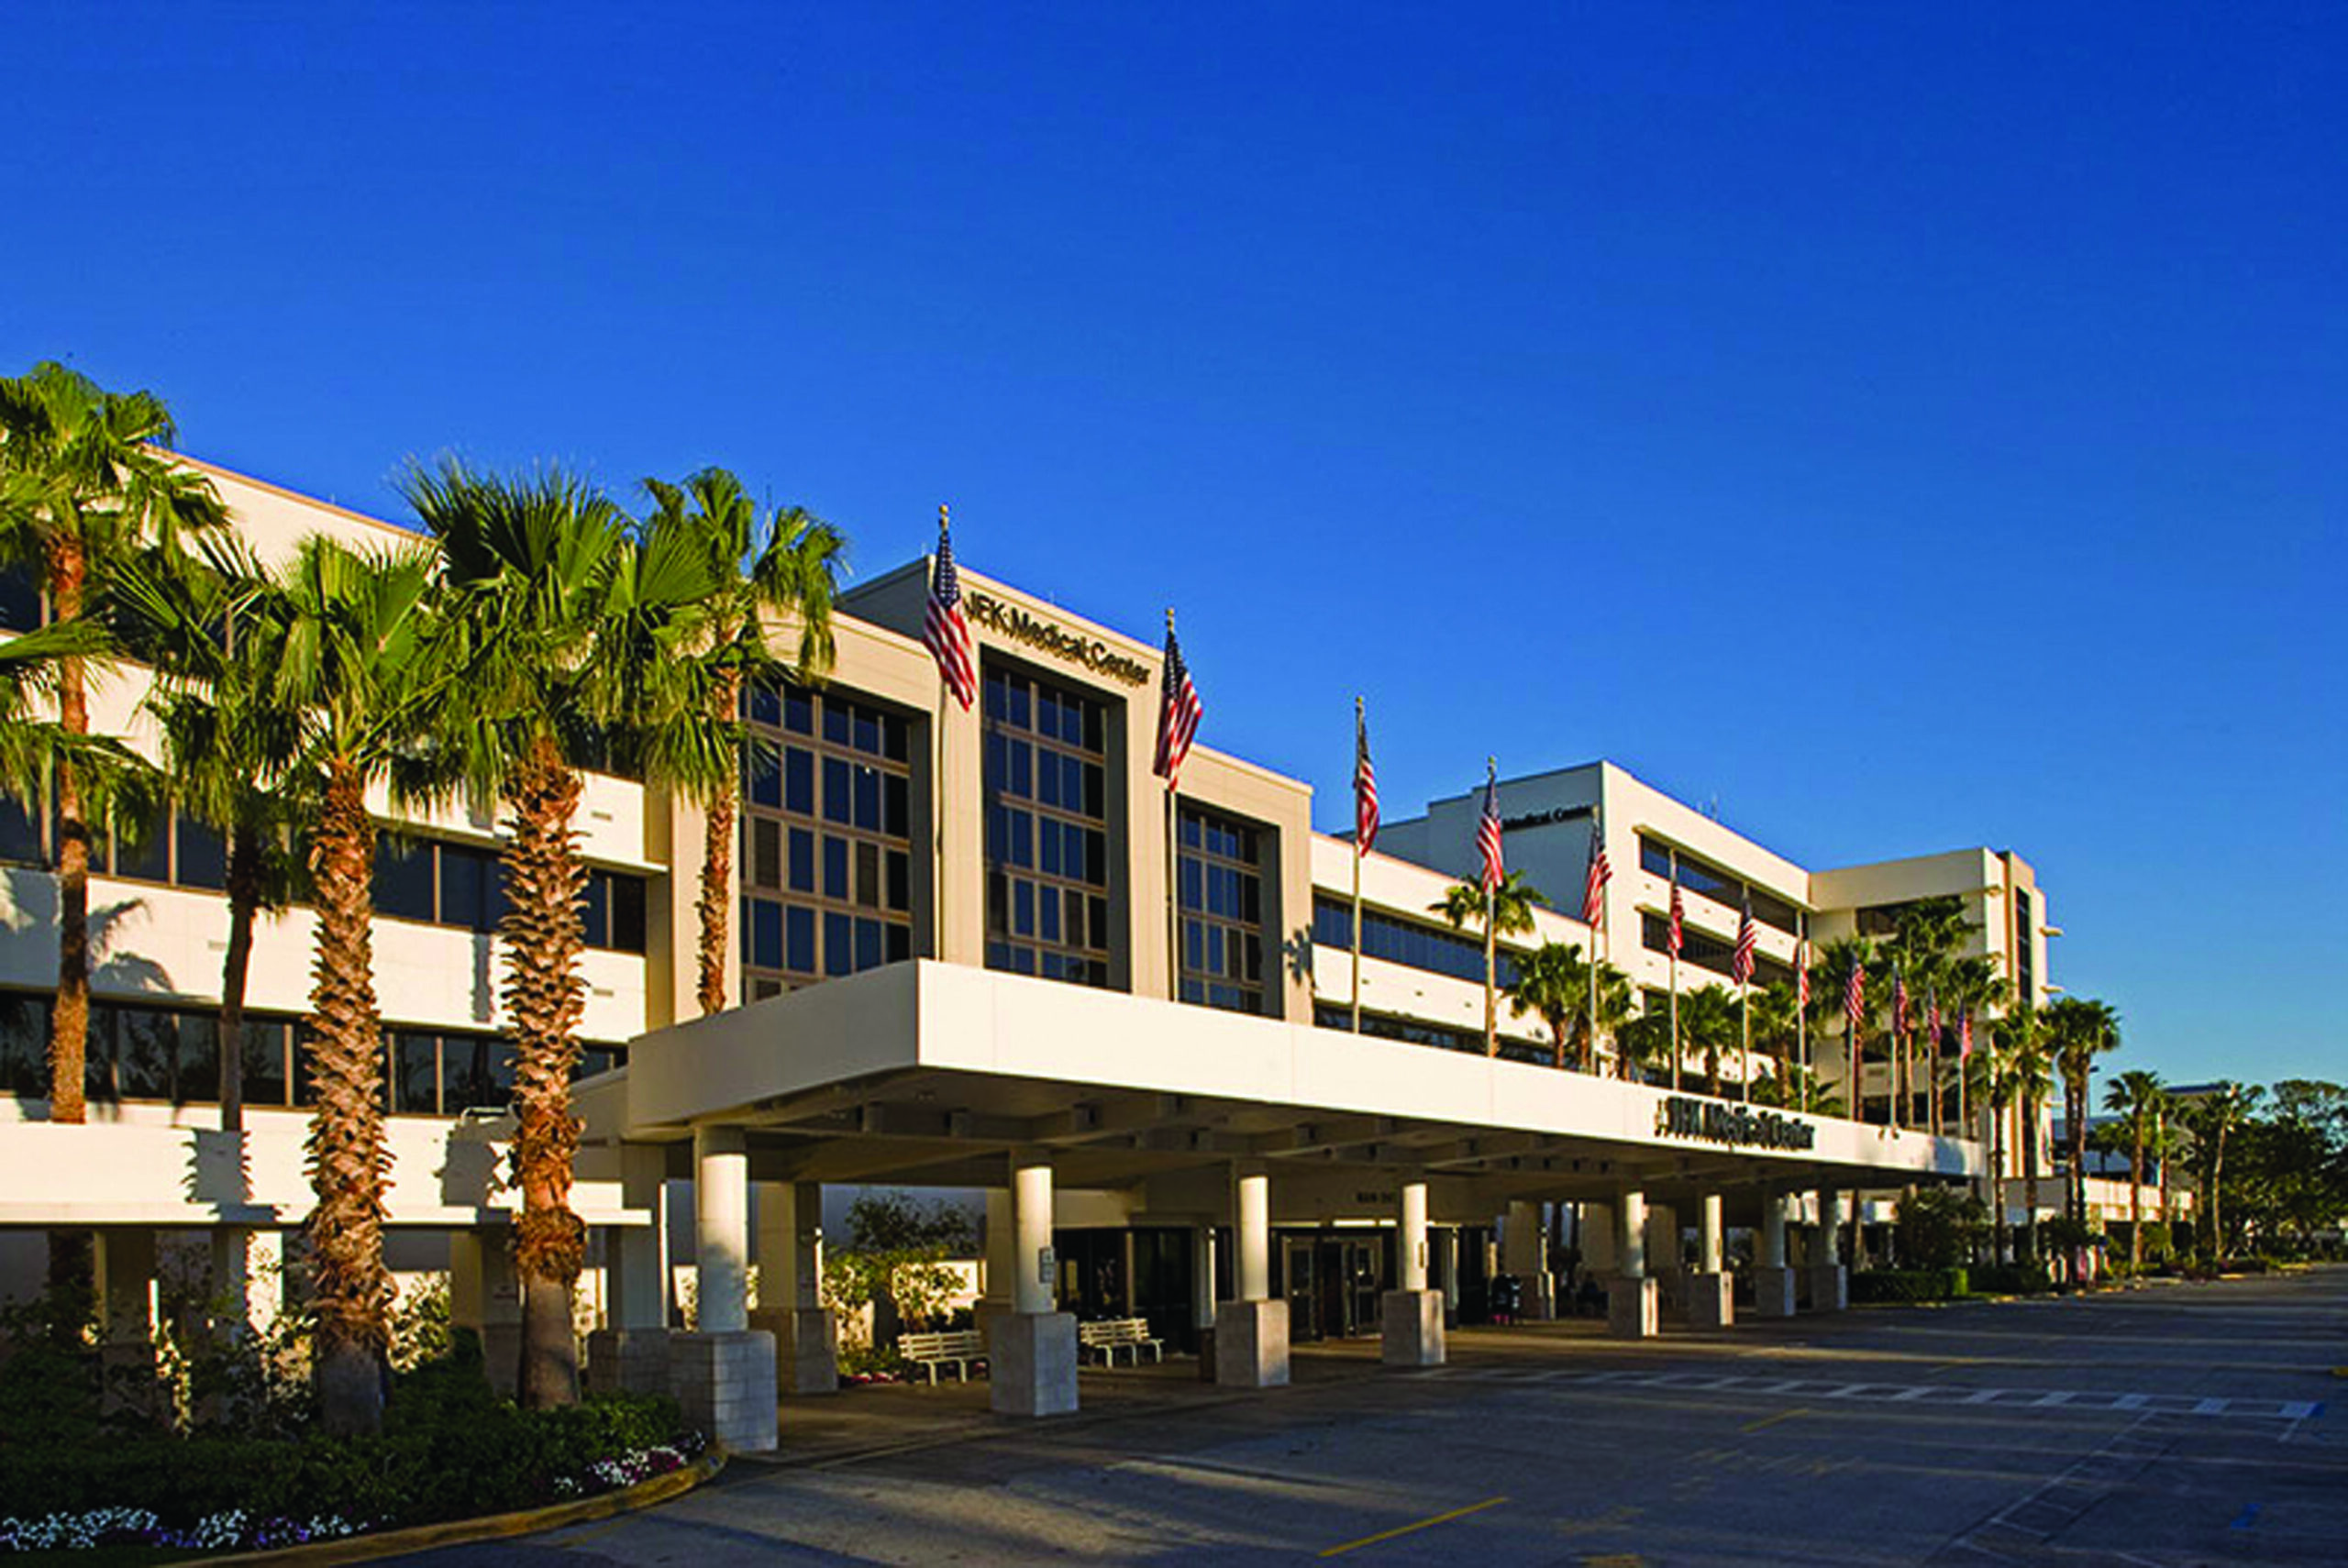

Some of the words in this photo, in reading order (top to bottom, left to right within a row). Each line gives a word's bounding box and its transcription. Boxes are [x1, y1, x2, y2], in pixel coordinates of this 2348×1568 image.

[963, 591, 1013, 637] JFK
[1011, 608, 1095, 670] Medical
[1091, 642, 1151, 687] Center
